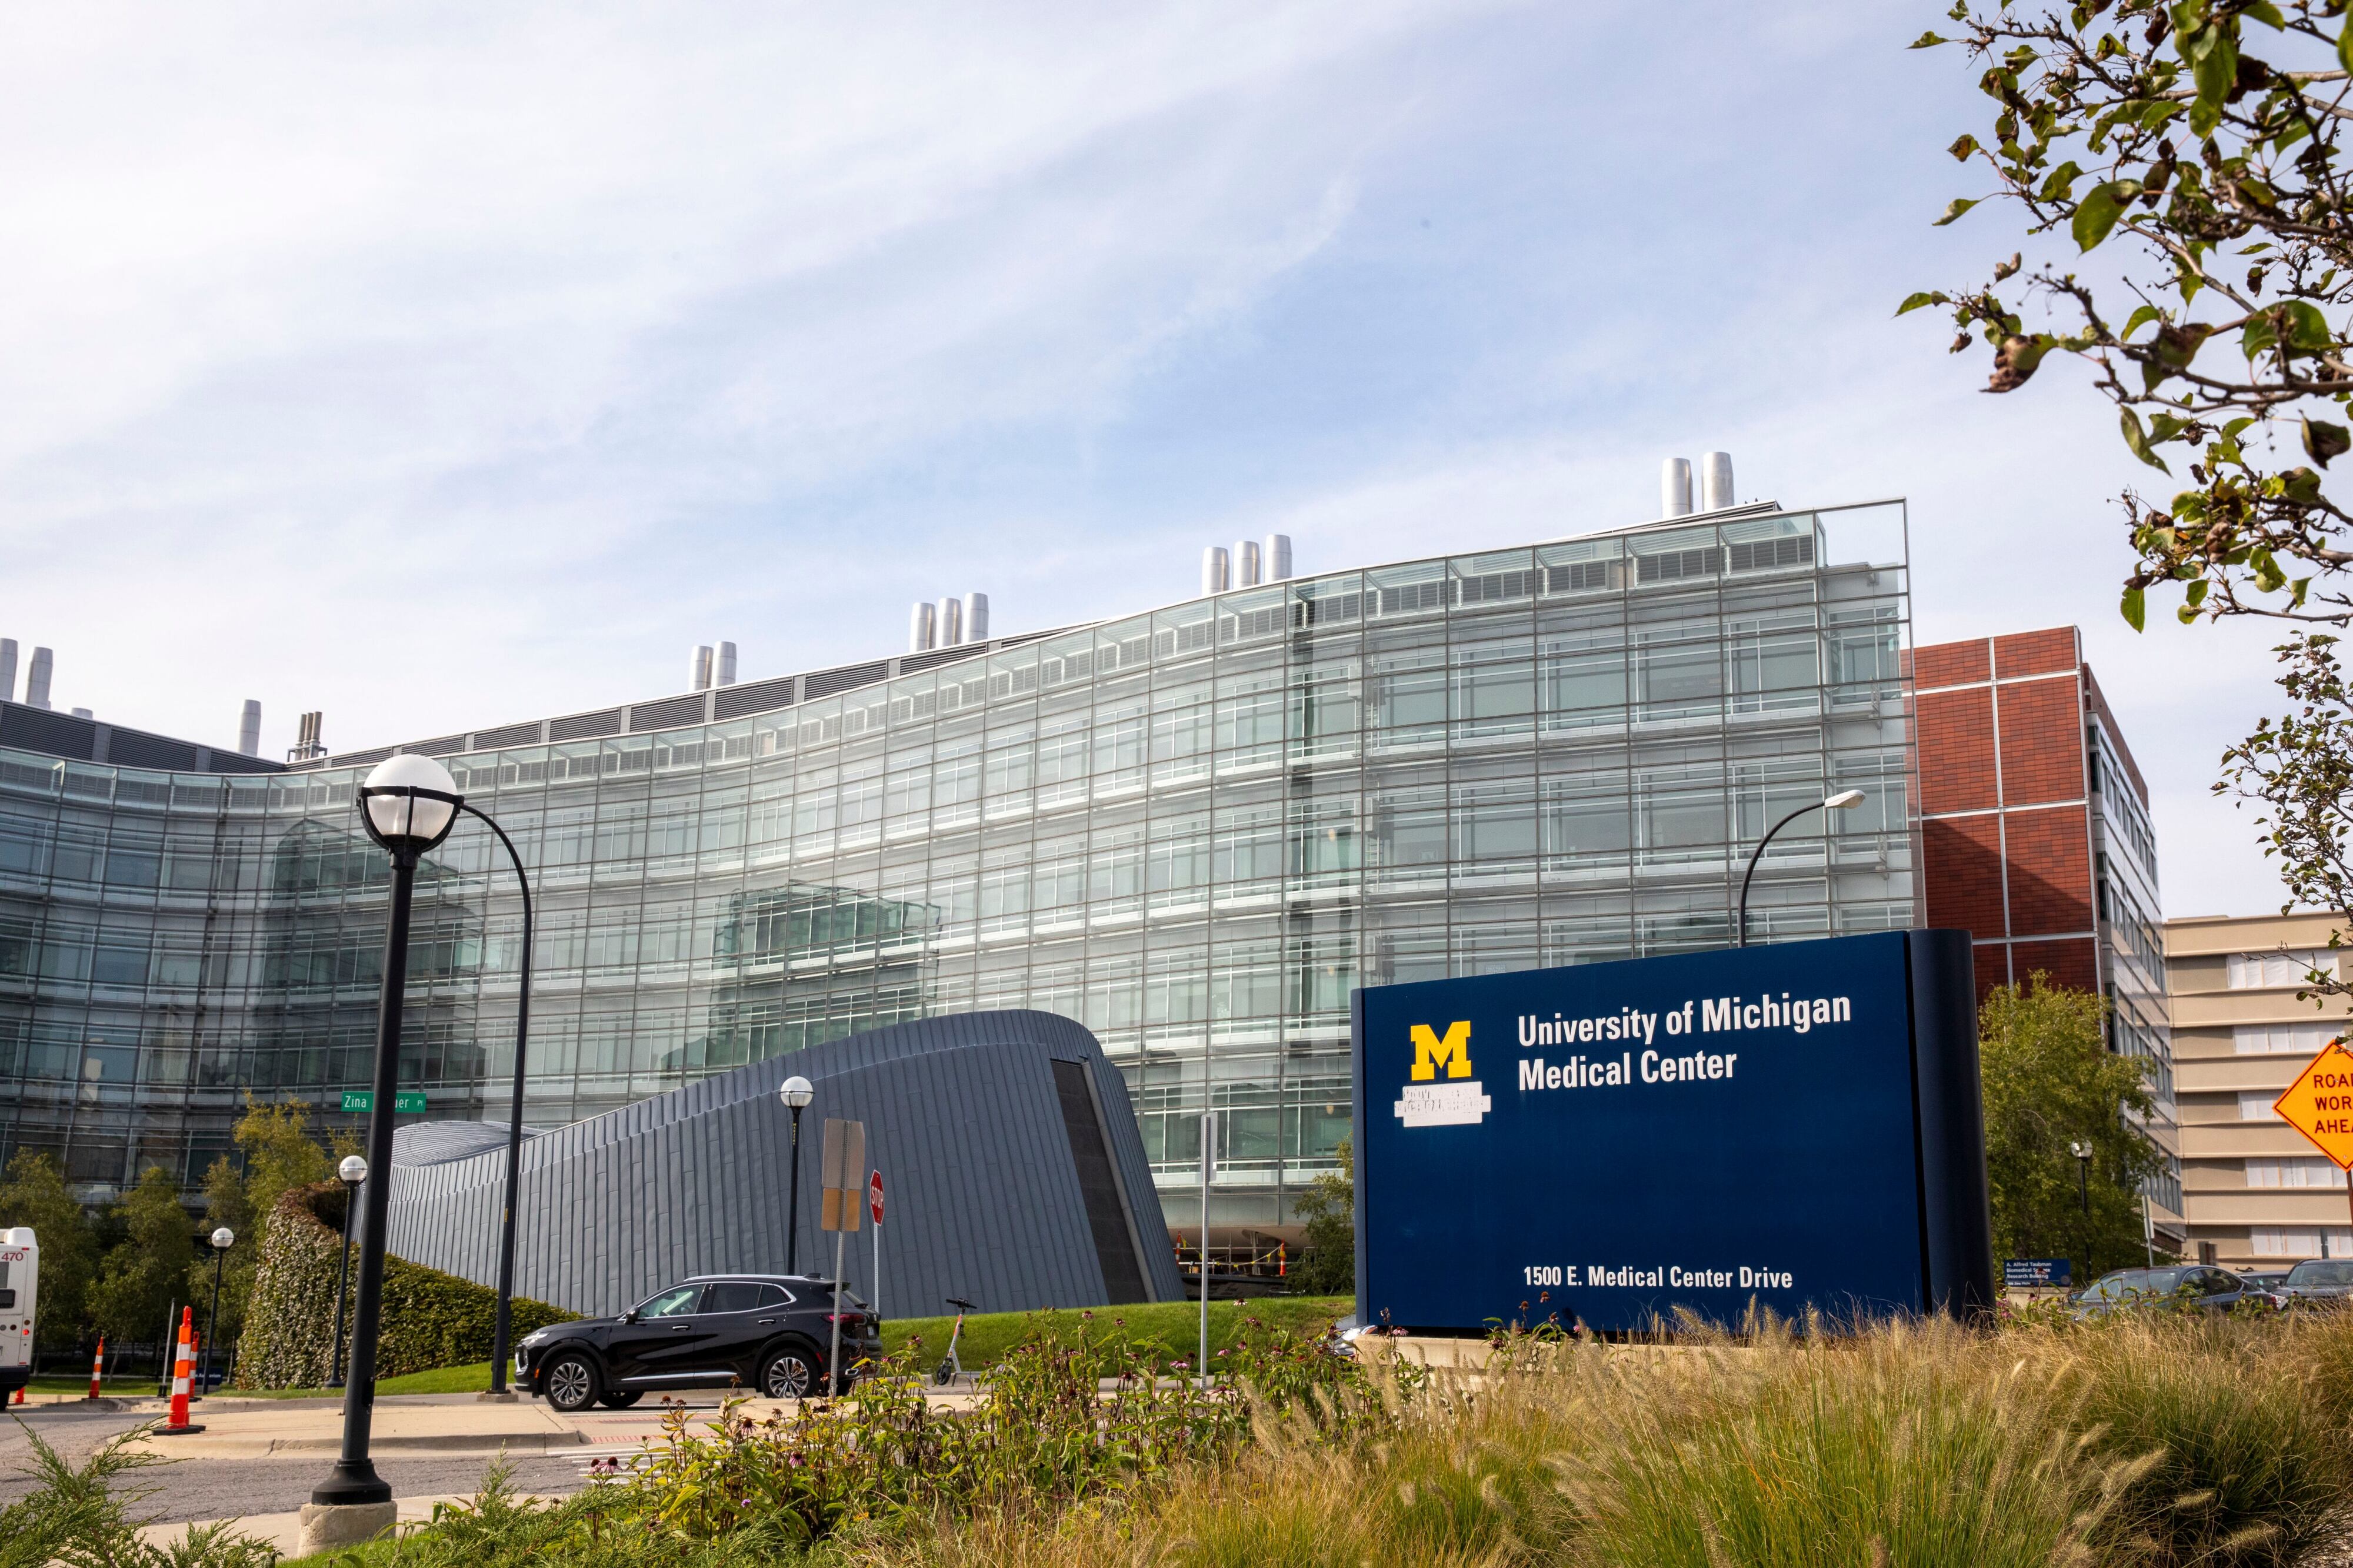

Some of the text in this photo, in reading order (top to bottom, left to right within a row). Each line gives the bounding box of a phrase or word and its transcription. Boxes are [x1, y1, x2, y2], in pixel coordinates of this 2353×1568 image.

[1518, 992, 1851, 1047] University of Michigan
[1410, 1020, 1472, 1081] M
[1519, 1050, 1737, 1091] Medical Center
[344, 1095, 366, 1107] Zina
[2315, 1119, 2353, 1133] AHE
[871, 1186, 884, 1209] STOP
[1, 1252, 24, 1261] 470
[1524, 1266, 1792, 1288] 1500 E. Medical Center Drive
